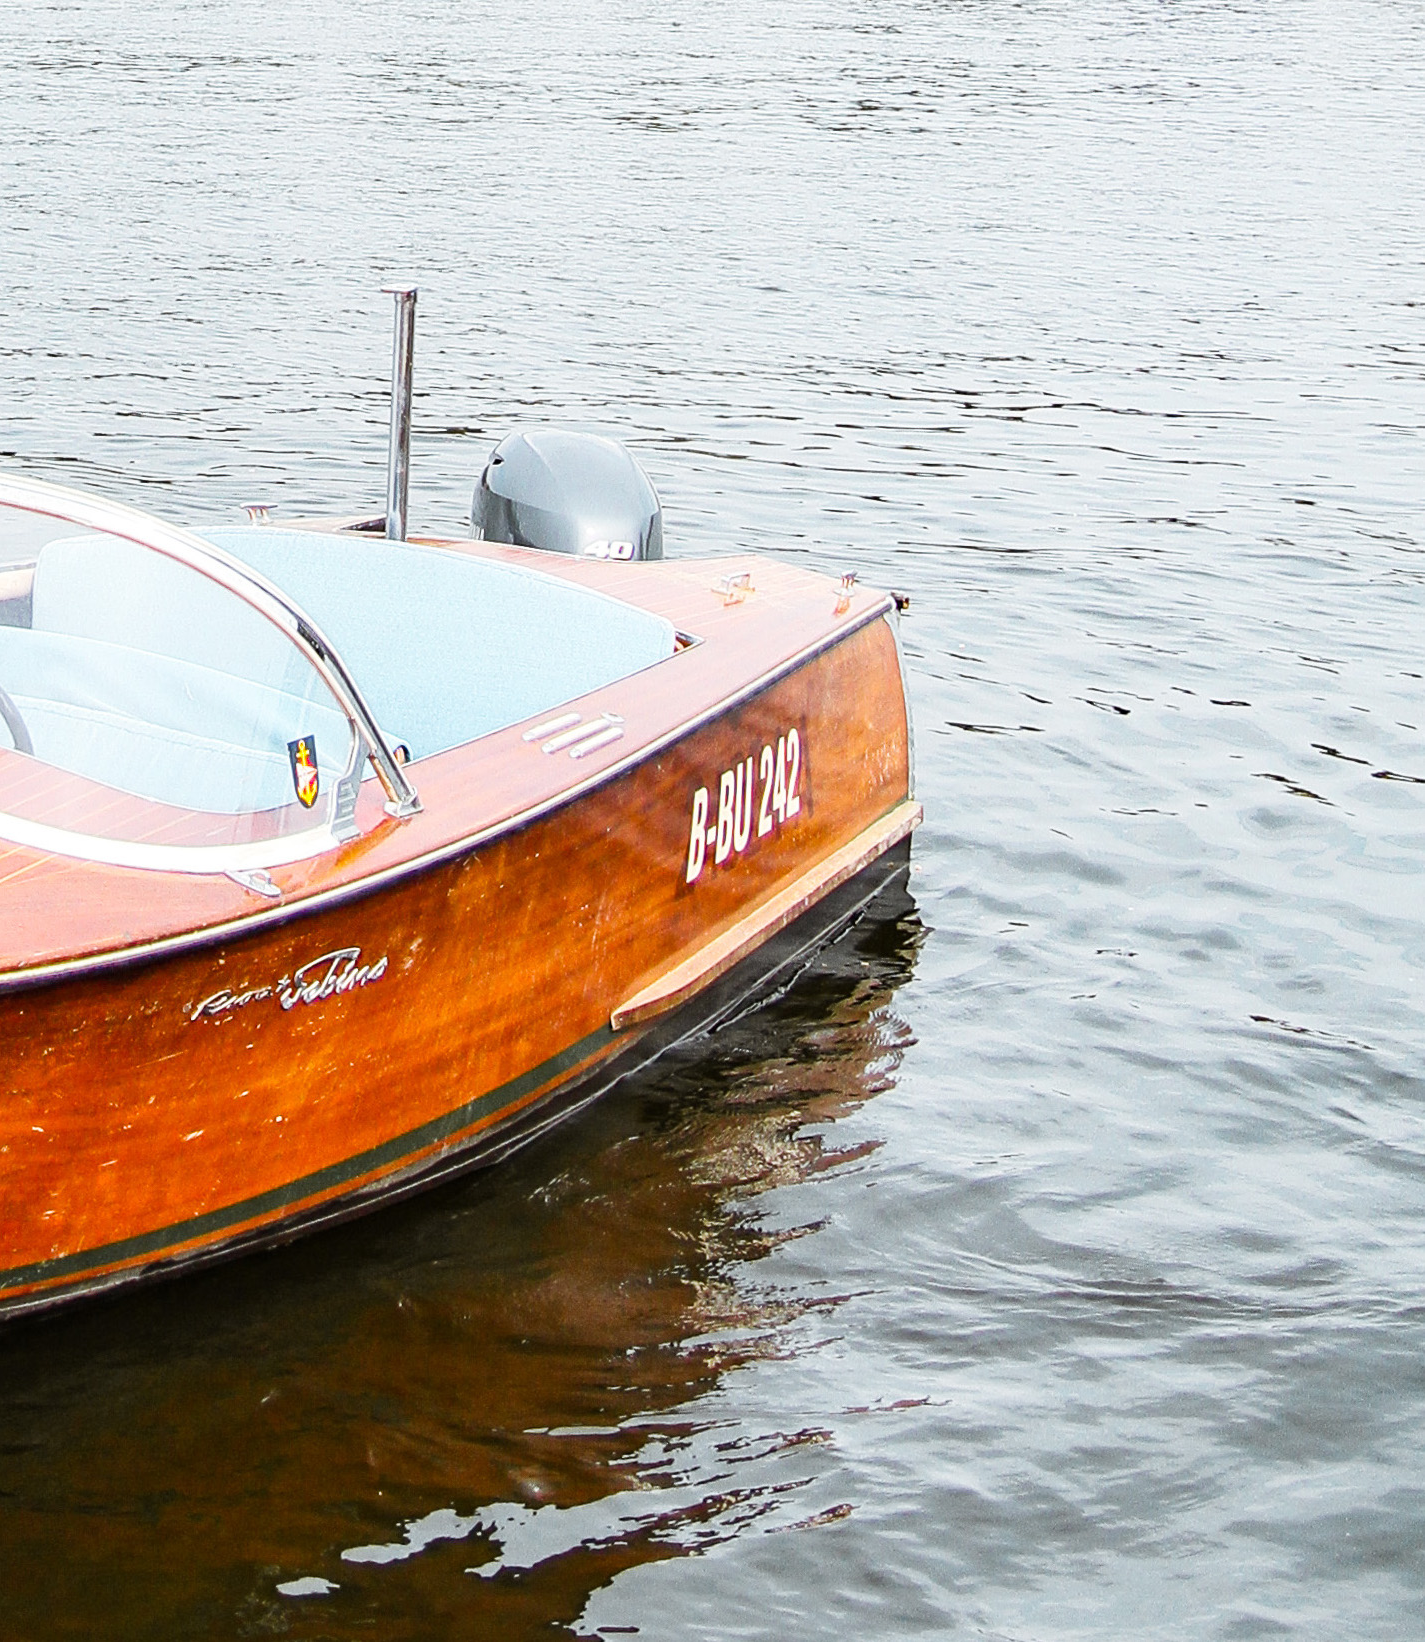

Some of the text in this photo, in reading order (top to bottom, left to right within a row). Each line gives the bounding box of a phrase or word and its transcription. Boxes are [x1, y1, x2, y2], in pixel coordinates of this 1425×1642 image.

[583, 540, 635, 561] 40
[686, 727, 801, 884] B-BU 242
